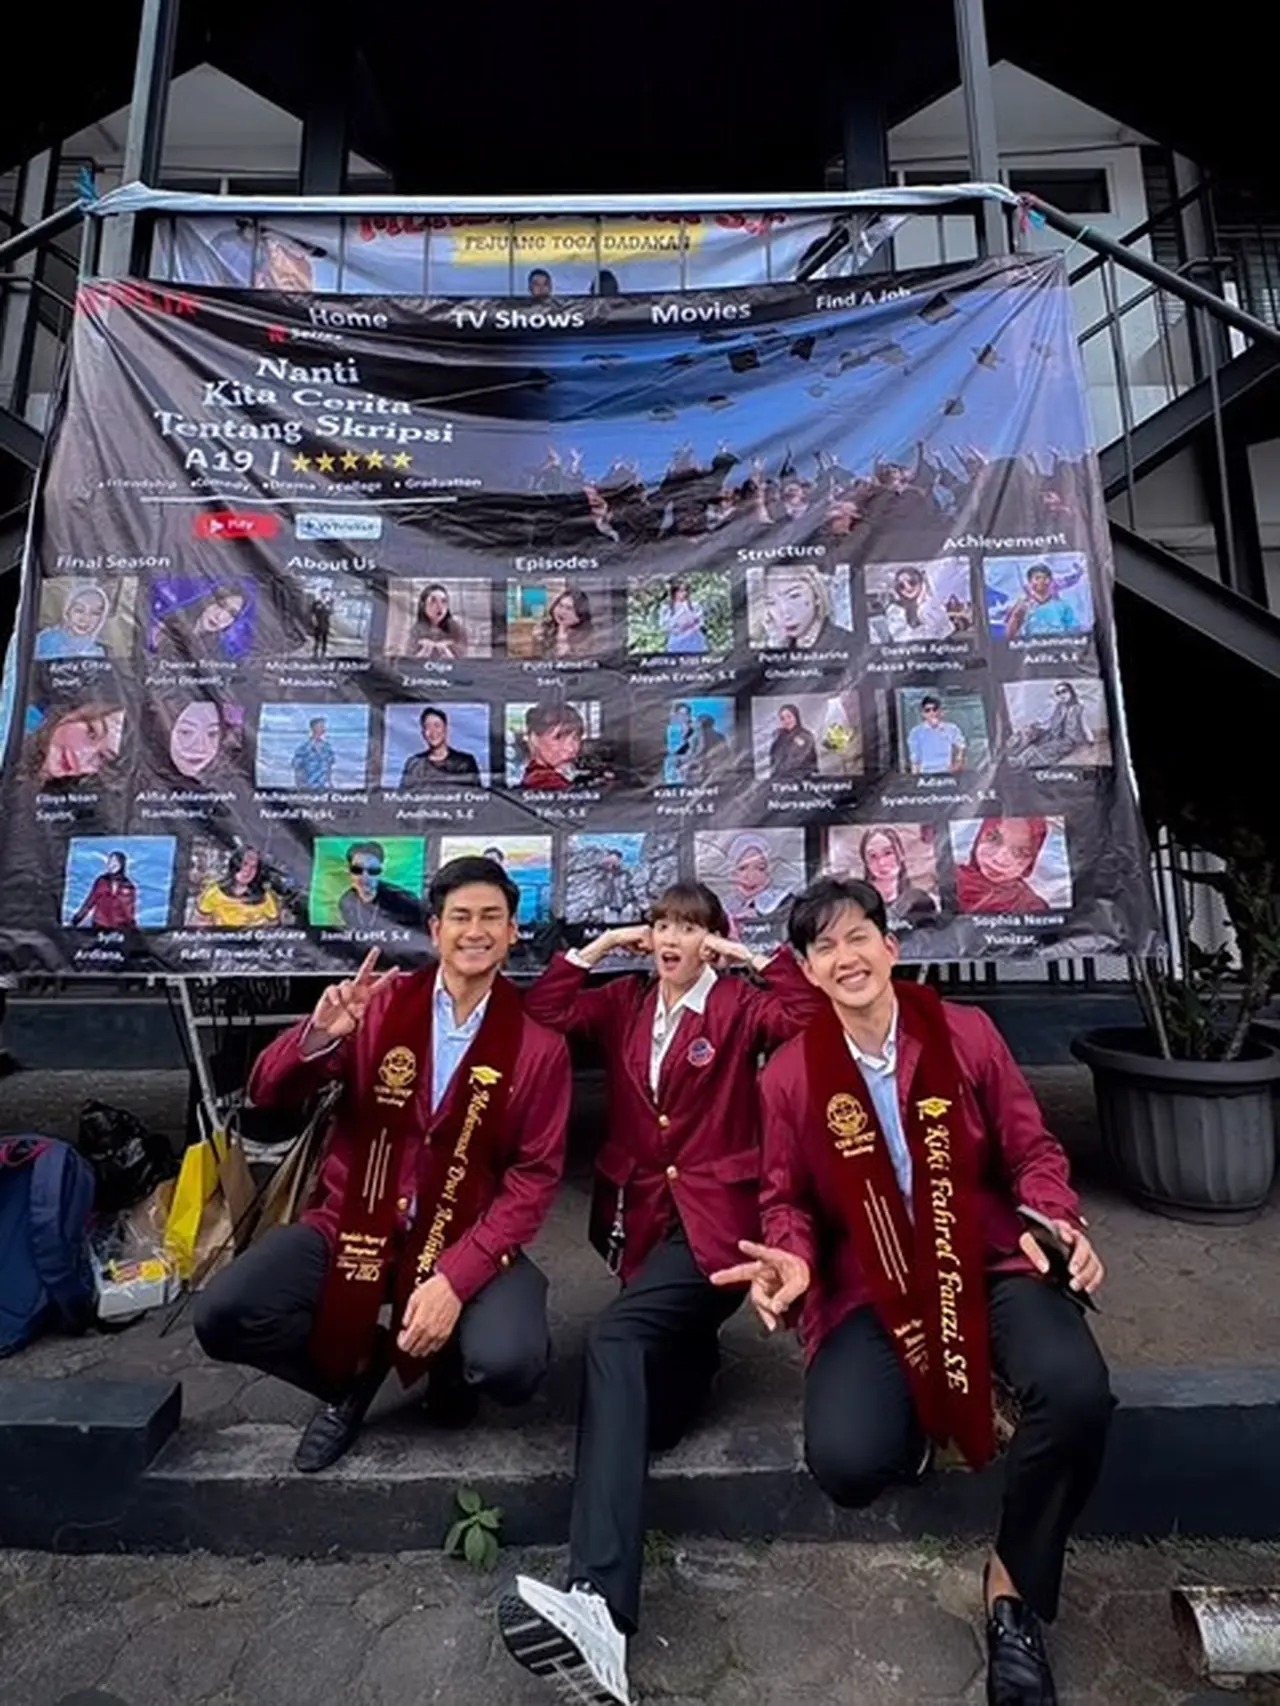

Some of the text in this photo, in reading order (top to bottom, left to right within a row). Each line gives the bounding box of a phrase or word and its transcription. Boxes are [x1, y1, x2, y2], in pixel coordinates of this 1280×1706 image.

[464, 234, 546, 250] PEJUANG
[308, 308, 388, 329] Home
[452, 310, 484, 329] TV
[495, 310, 585, 329] Shows
[651, 302, 752, 325] Movies
[815, 291, 856, 310] Find
[861, 290, 875, 306] A
[254, 357, 361, 384] Nanti
[201, 380, 413, 416] Kita Cerita
[153, 409, 454, 445] Tentang Skripsi
[404, 478, 483, 490] Graduation
[942, 532, 1067, 551] Achievement
[56, 554, 171, 569] Final Season
[736, 543, 826, 562] Structure
[287, 555, 377, 571] About Us
[515, 556, 599, 572] Episodes
[383, 791, 461, 802] Muhammad
[171, 930, 253, 942] Muhammad
[925, 1124, 952, 1172] Kiki
[931, 1177, 962, 1267] Fahrel
[937, 1269, 966, 1344] Fauzi,
